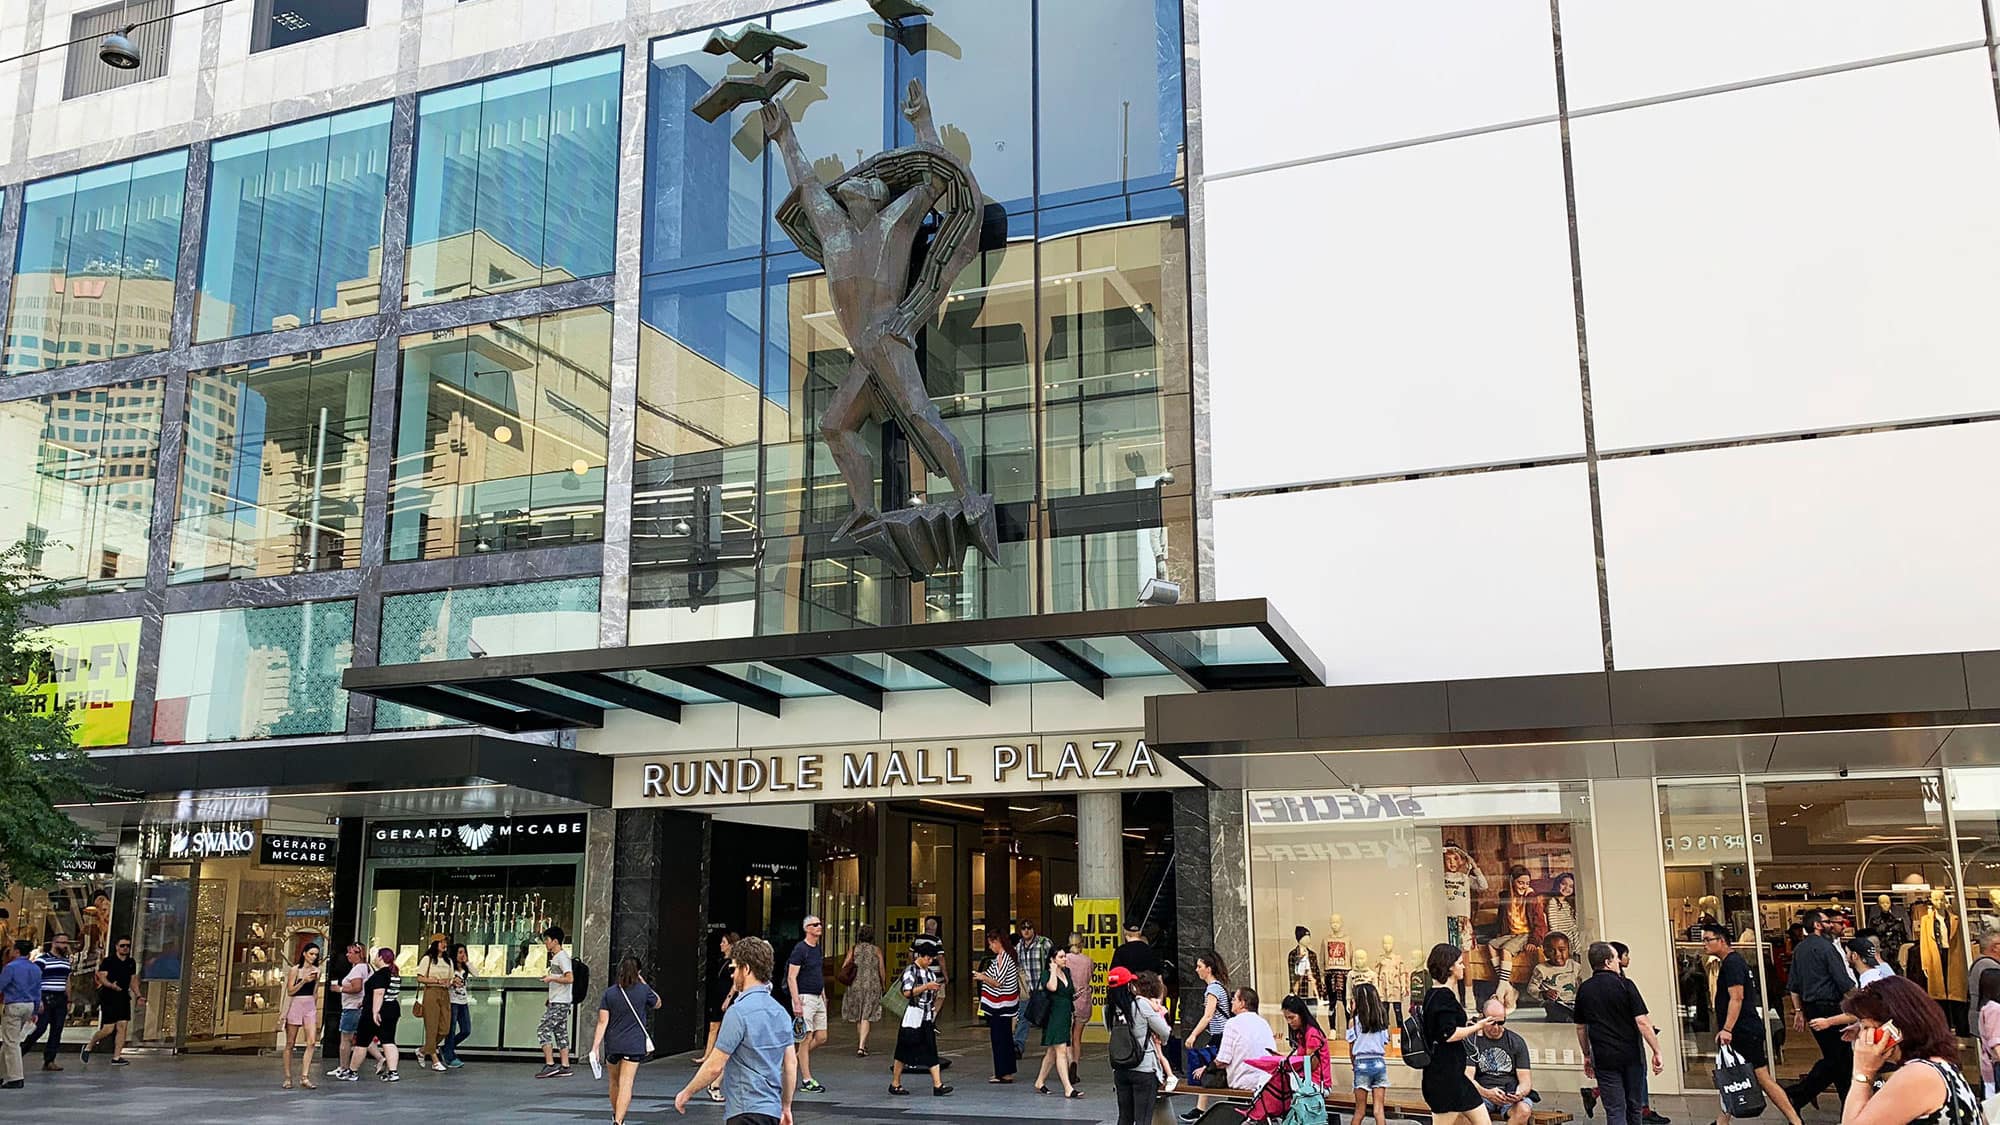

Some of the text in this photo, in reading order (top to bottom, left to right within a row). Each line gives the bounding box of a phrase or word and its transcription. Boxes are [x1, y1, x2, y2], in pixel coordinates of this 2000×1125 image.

[643, 739, 1161, 798] RUNDLE MALL PLAZA
[376, 827, 451, 840] GERARD
[192, 831, 254, 852] SWARO
[272, 839, 327, 850] GERARD
[888, 918, 918, 932] JB
[1076, 914, 1118, 934] JB
[1093, 963, 1108, 972] PEN
[1092, 975, 1104, 983] ON
[1724, 1078, 1752, 1094] rebel
